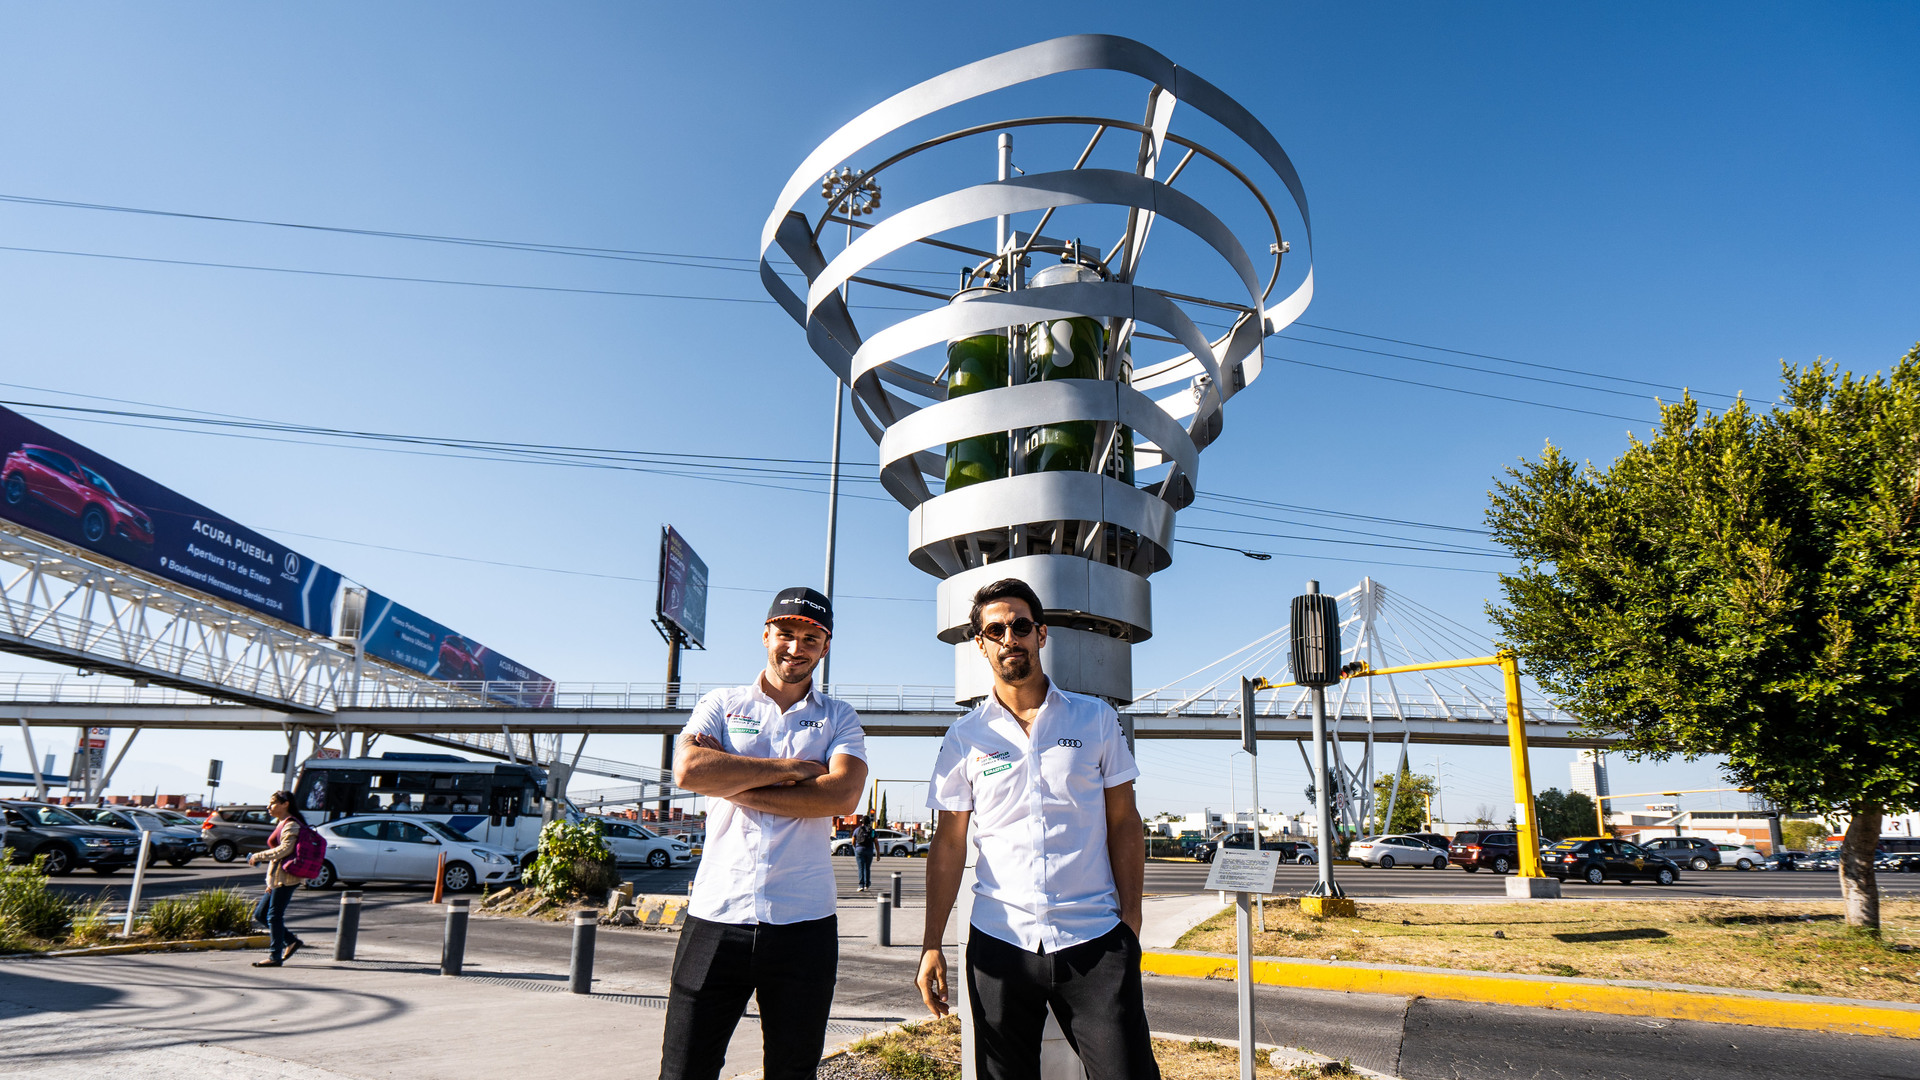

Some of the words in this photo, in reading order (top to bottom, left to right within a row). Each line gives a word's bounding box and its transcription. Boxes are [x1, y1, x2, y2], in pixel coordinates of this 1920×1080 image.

[192, 520, 233, 547] ACURA
[234, 538, 274, 565] PUEBLA
[168, 559, 206, 582] Boulevard
[207, 575, 242, 595] Hermanos
[187, 543, 225, 566] Apertura
[227, 560, 237, 571] 13
[237, 565, 248, 576] de
[249, 568, 271, 585] Enero
[280, 571, 299, 584] ACURA
[780, 597, 826, 613] e-tron
